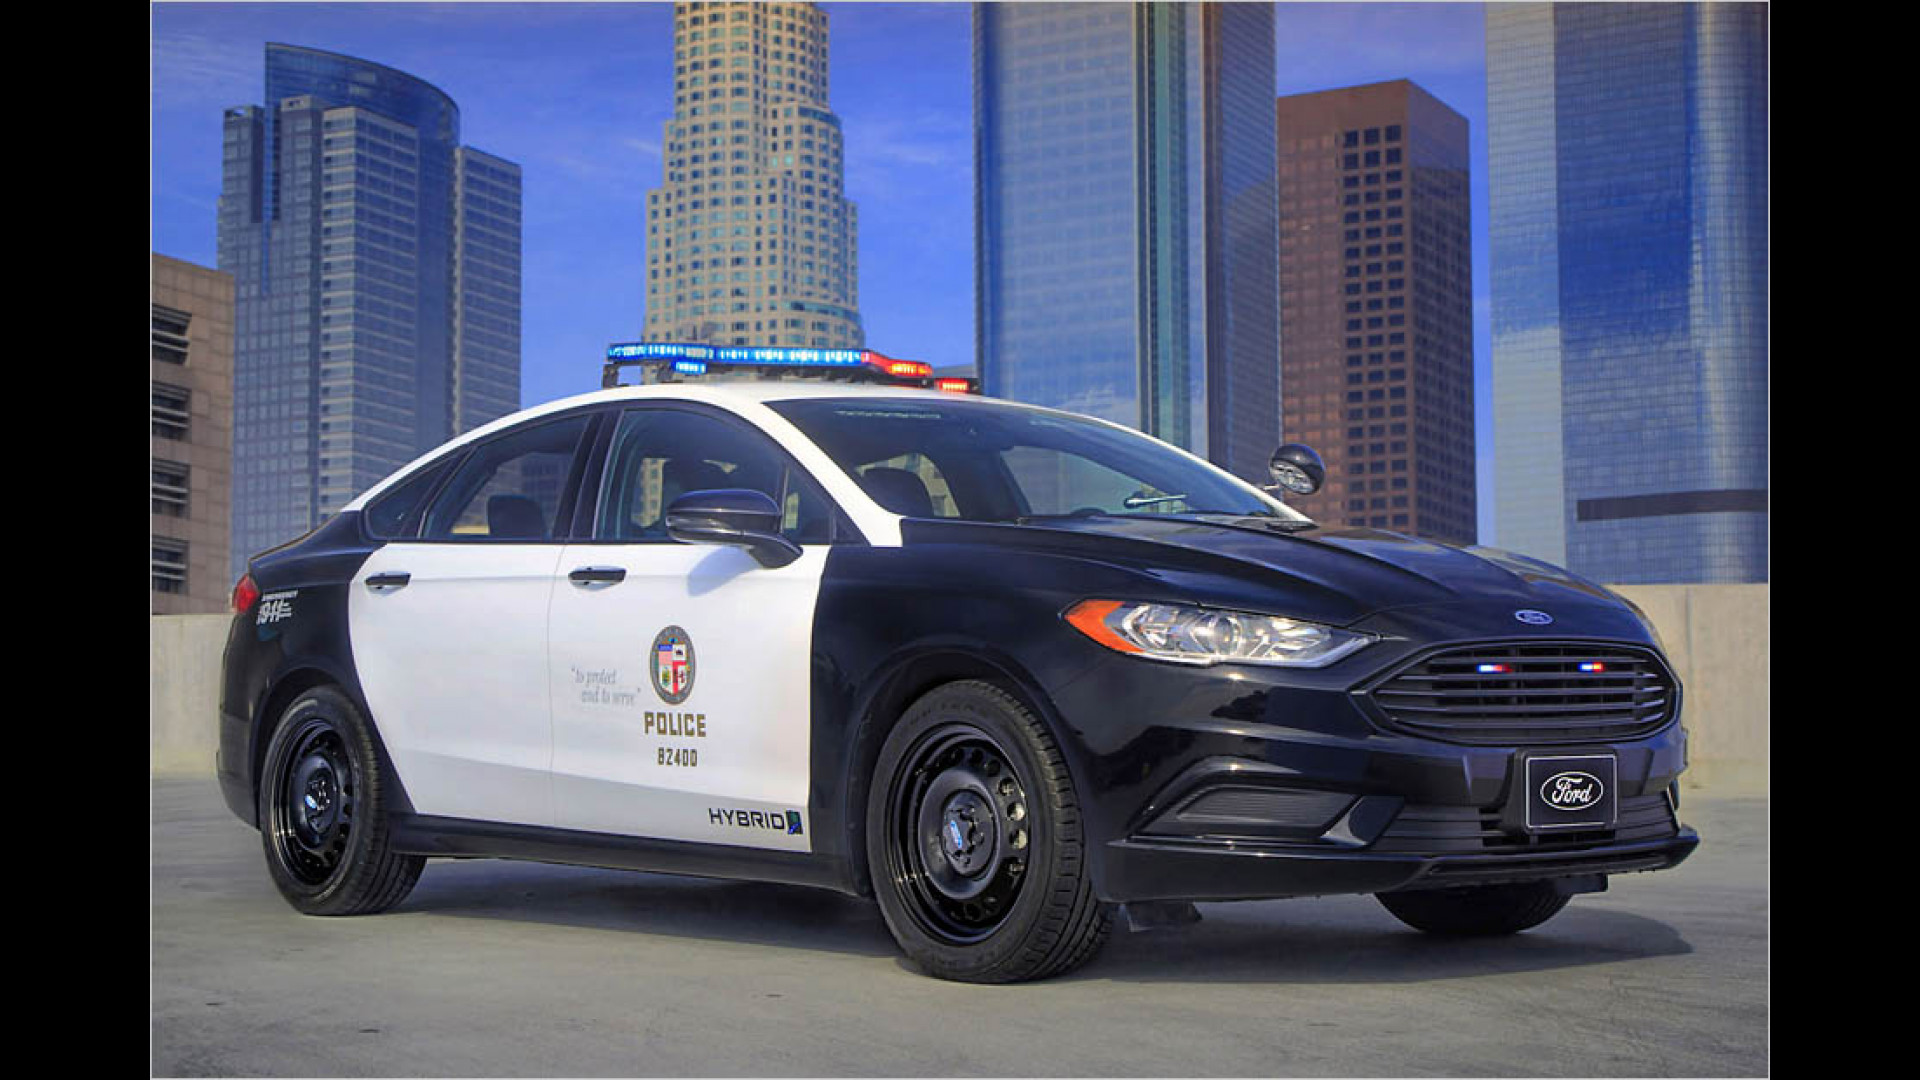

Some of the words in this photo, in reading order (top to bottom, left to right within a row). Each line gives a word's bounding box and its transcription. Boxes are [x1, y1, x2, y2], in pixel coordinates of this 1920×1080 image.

[586, 669, 616, 688] protect
[581, 686, 599, 703] and
[602, 687, 611, 703] to
[644, 711, 707, 737] POLICE
[657, 747, 698, 767] 82400
[1552, 777, 1594, 803] Ford
[708, 807, 785, 830] HYBRID
